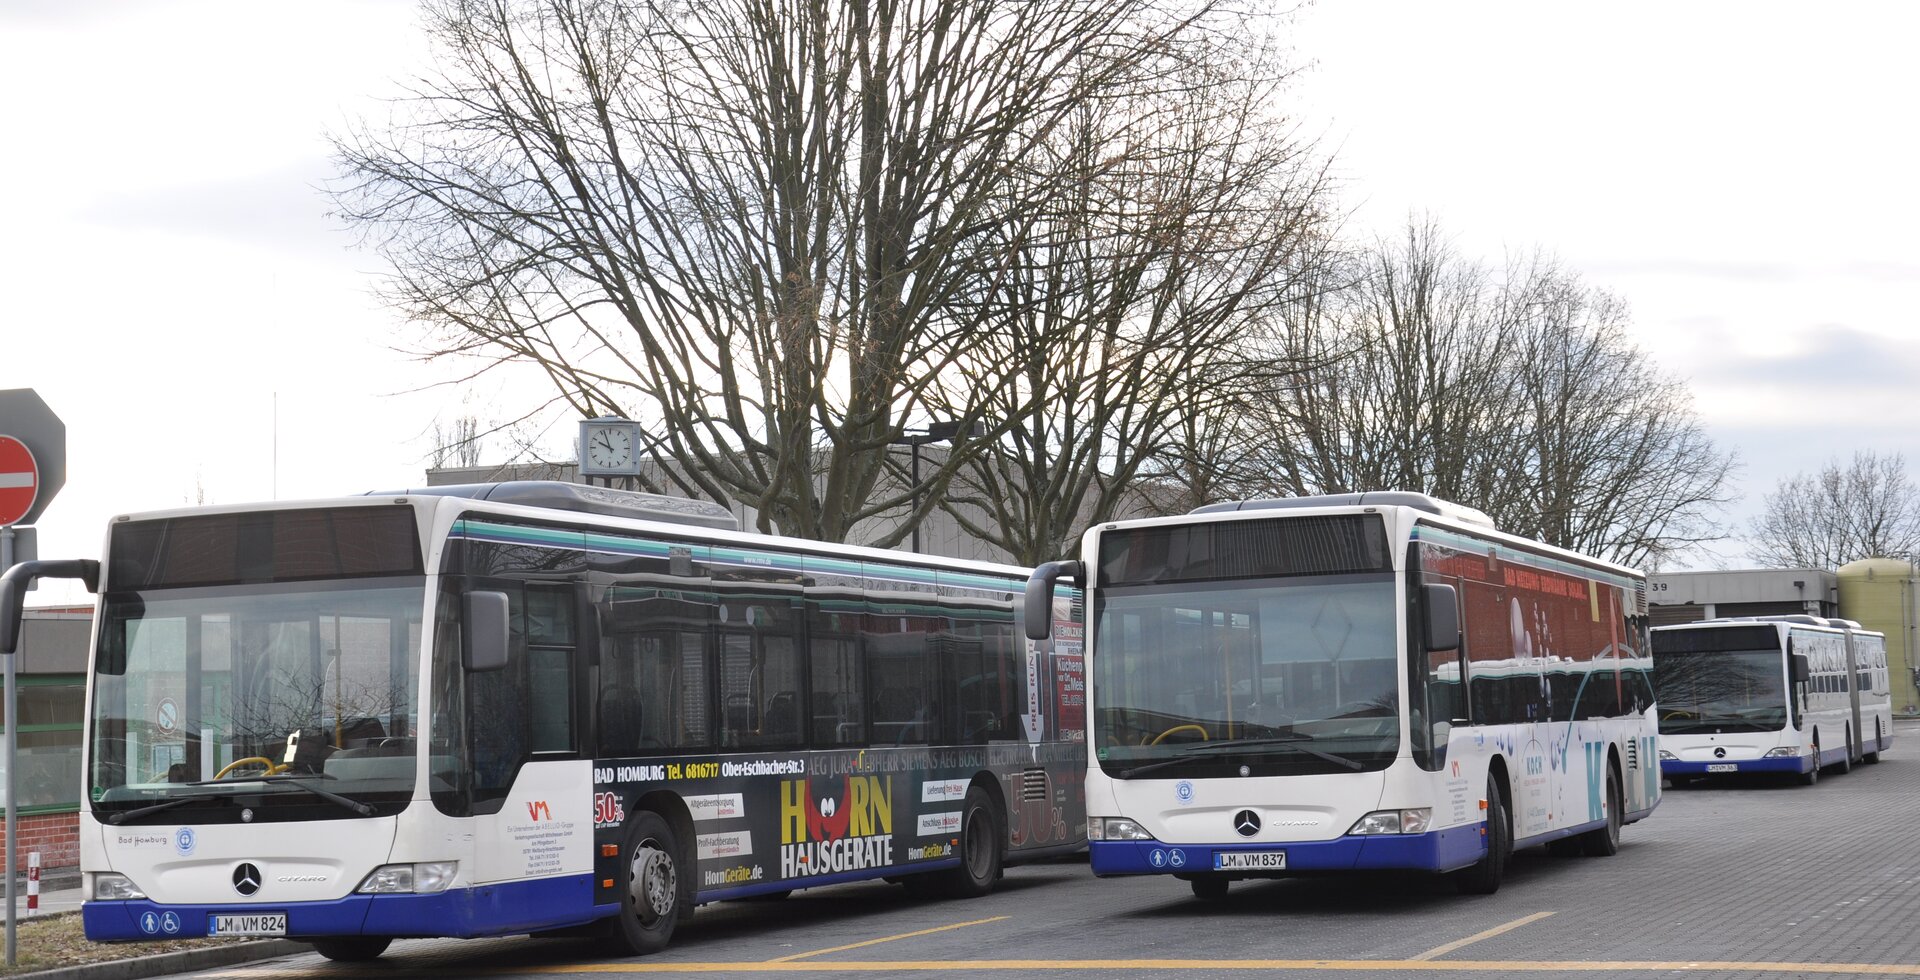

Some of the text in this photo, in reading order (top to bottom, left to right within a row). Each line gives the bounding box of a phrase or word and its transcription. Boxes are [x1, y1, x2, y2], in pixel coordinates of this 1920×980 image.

[594, 766, 614, 784] BAD
[617, 765, 665, 783] HOMBURG
[667, 763, 683, 780] Tel.
[685, 762, 719, 779] 6816717
[807, 755, 827, 775] AEG
[830, 754, 853, 779] JURA
[901, 750, 938, 771] SIEMENS
[940, 750, 956, 769] AEG
[958, 748, 987, 767] BOSCH
[1526, 755, 1543, 776] KOCH
[594, 791, 625, 824] 50%
[118, 836, 167, 847] Bad Homburg
[908, 843, 952, 861] HornGeräte.de
[781, 834, 893, 879] HAUSGERÄTE
[1221, 854, 1284, 867] LM VM 837
[276, 875, 328, 883] CITARO
[705, 864, 763, 886] HornGeräte.de
[216, 916, 284, 932] LM VM 824
